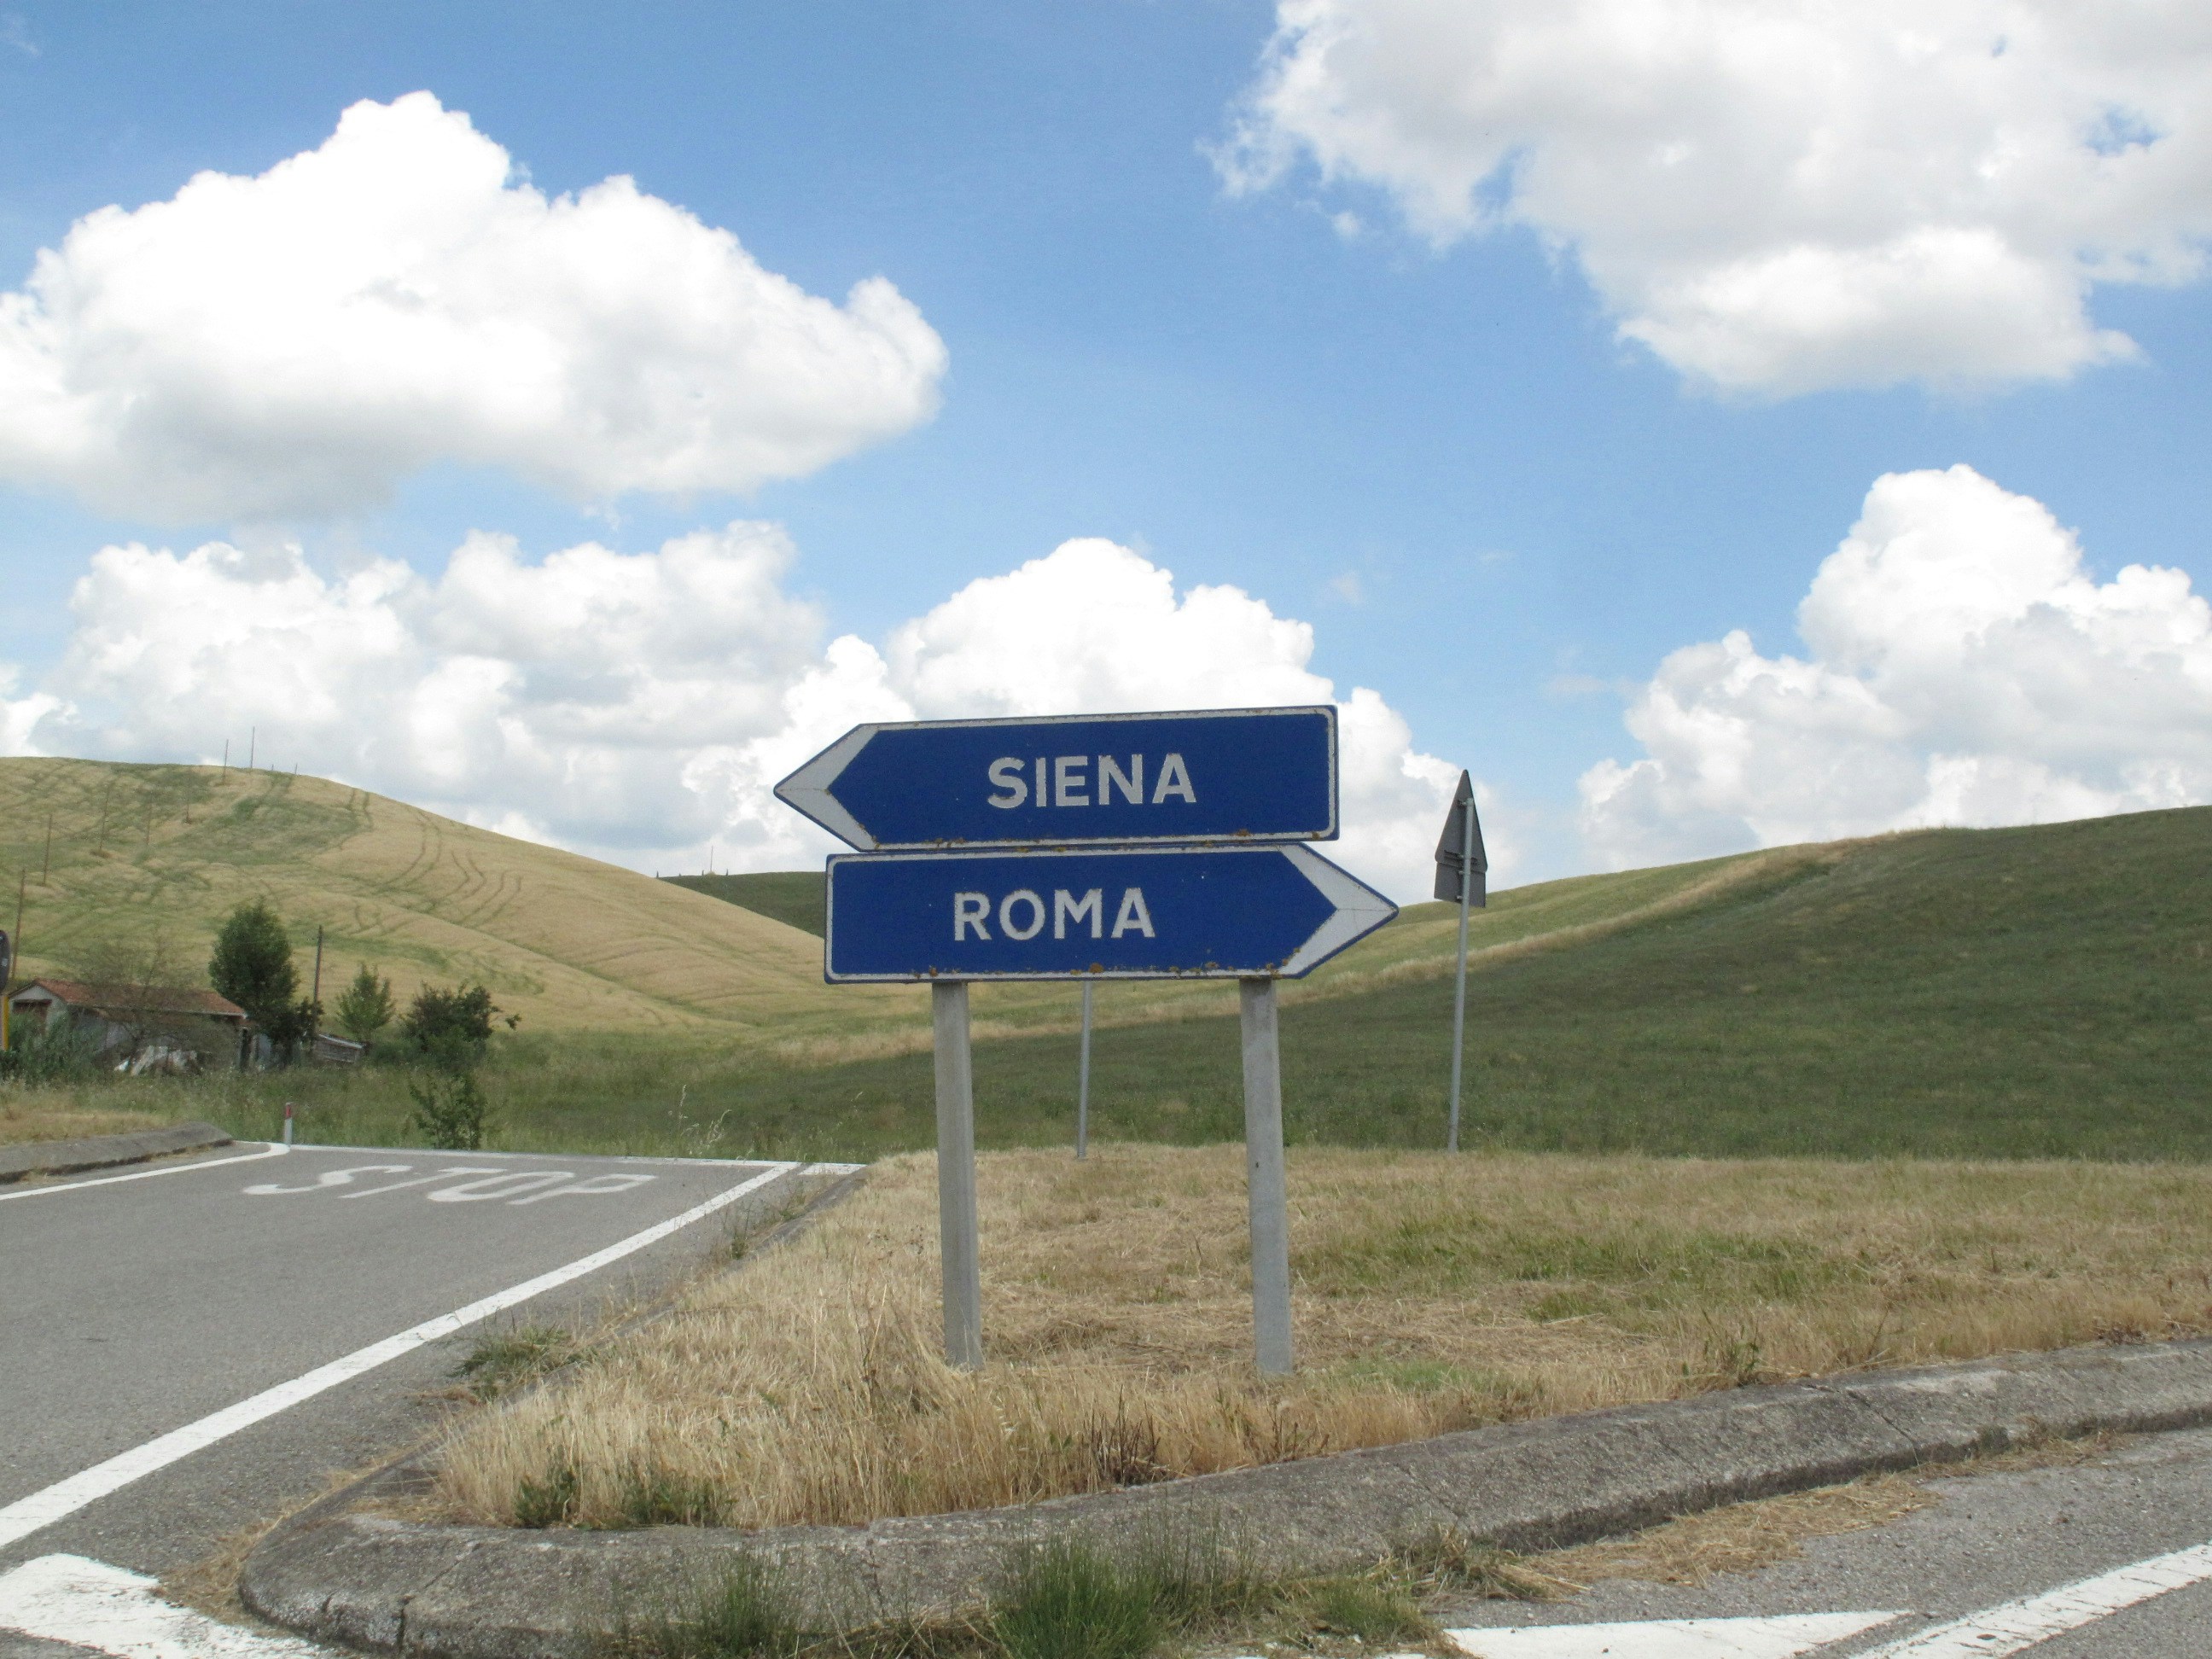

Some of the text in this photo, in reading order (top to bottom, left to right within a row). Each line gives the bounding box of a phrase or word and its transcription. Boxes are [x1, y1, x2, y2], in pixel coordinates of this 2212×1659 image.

[987, 753, 1197, 808] SIENA
[953, 888, 1156, 942] ROMA
[242, 1165, 658, 1205] STOP
